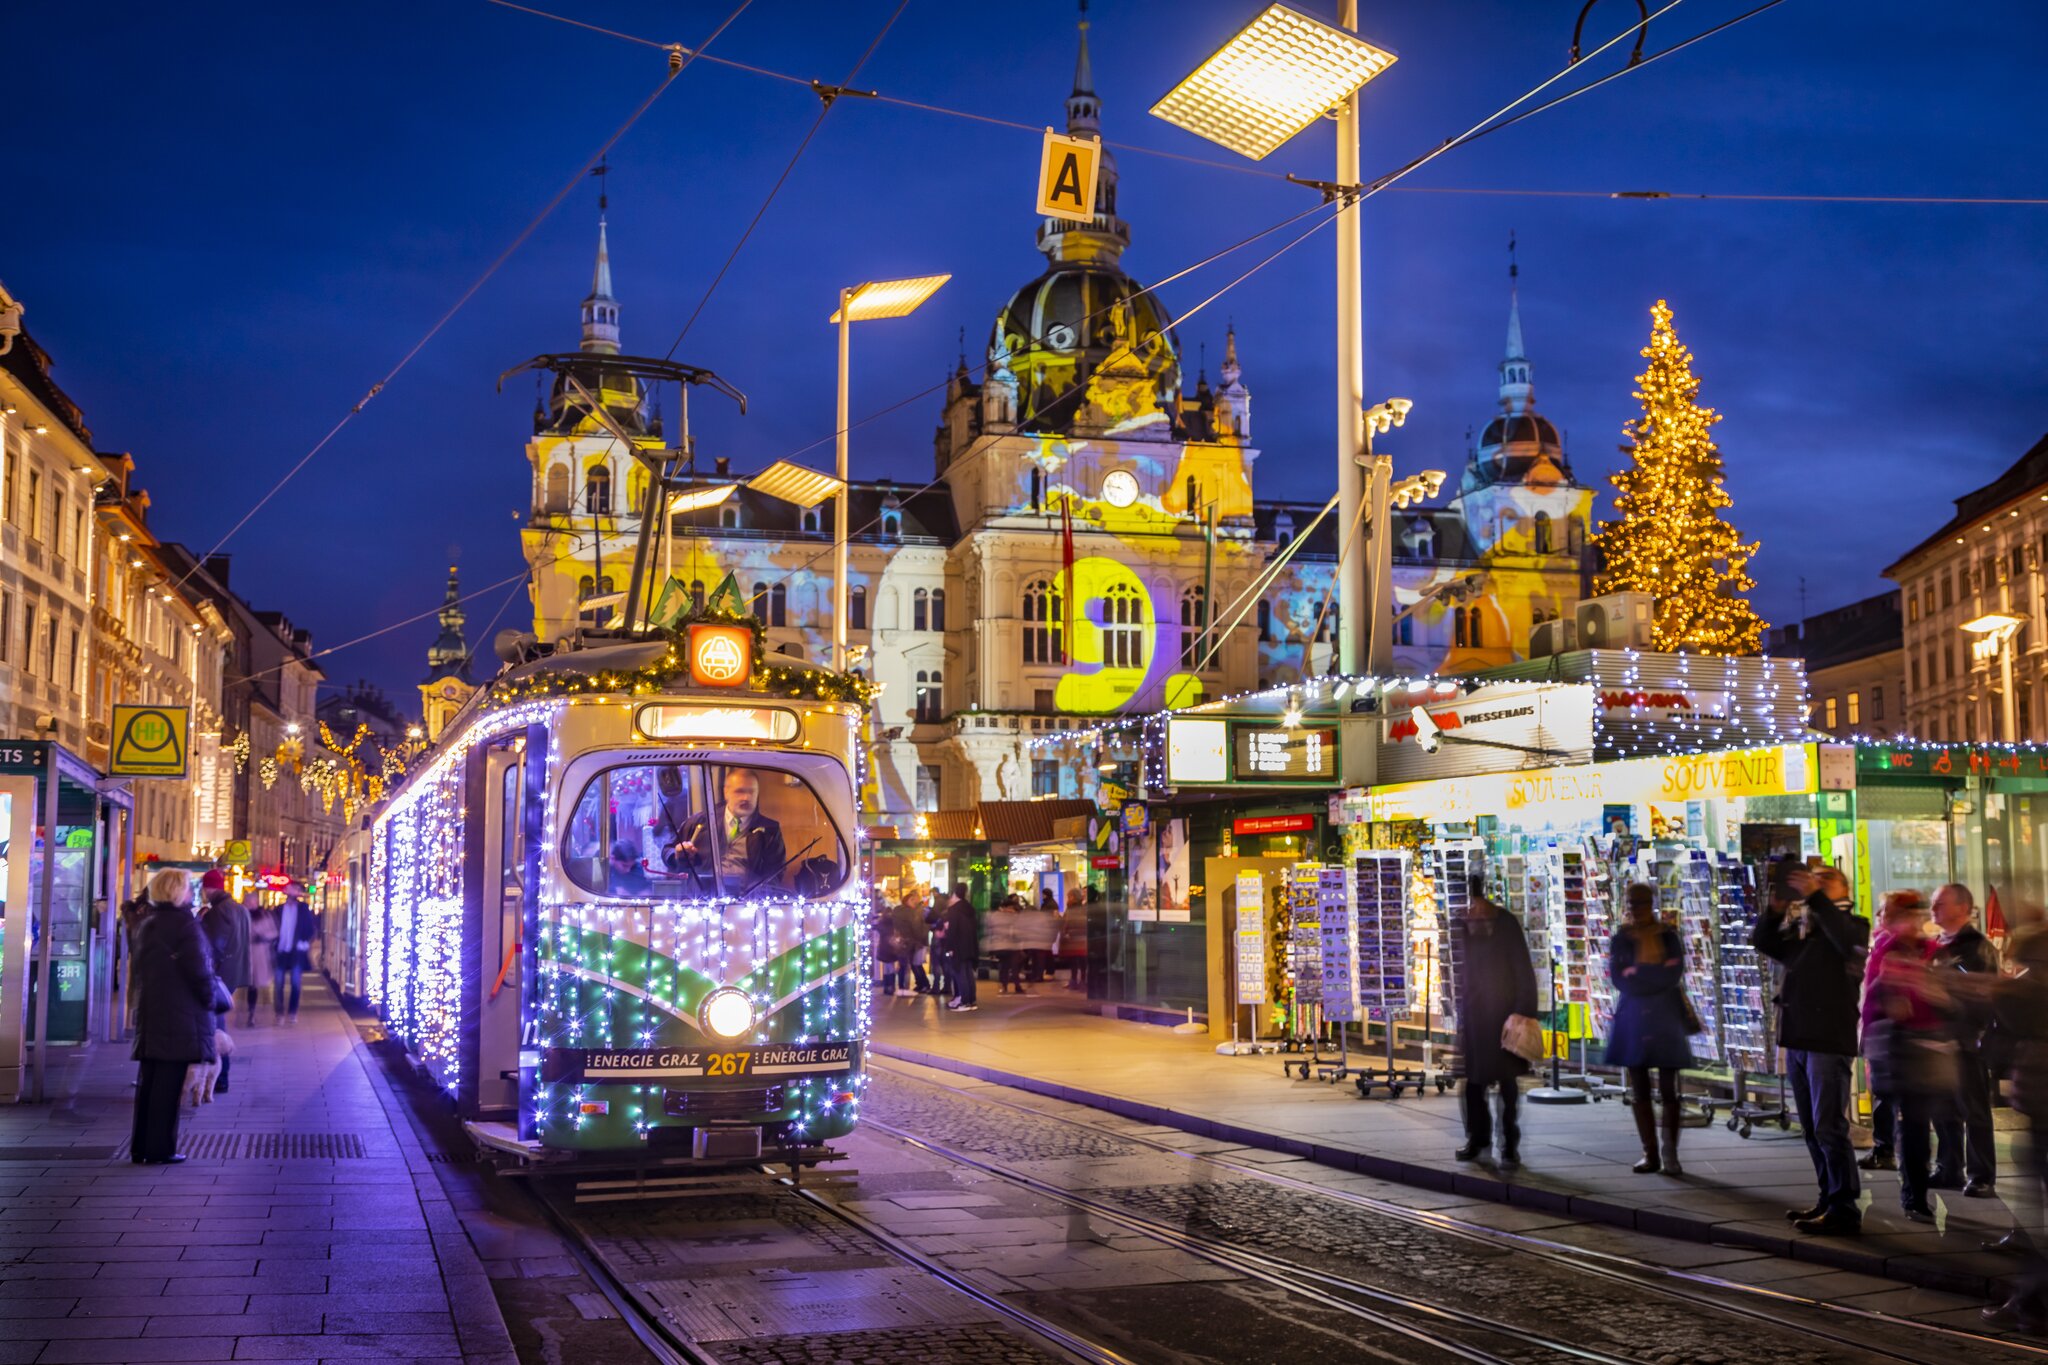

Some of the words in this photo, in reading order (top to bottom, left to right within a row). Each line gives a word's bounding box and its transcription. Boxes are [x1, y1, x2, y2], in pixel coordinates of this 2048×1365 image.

[1051, 152, 1083, 206] A
[1463, 706, 1535, 725] PRESSEHAUS
[0, 749, 23, 763] TS
[1891, 753, 1913, 767] WC
[1661, 756, 1778, 793] SOUVENIR
[200, 755, 216, 823] HUMANIC
[217, 767, 232, 829] HUMANIC
[594, 1055, 654, 1067] ENERGIE
[659, 1053, 700, 1066] GRAZ
[707, 1052, 751, 1076] 267
[762, 1050, 817, 1064] ENERGIE
[822, 1048, 849, 1061] GRAZ
